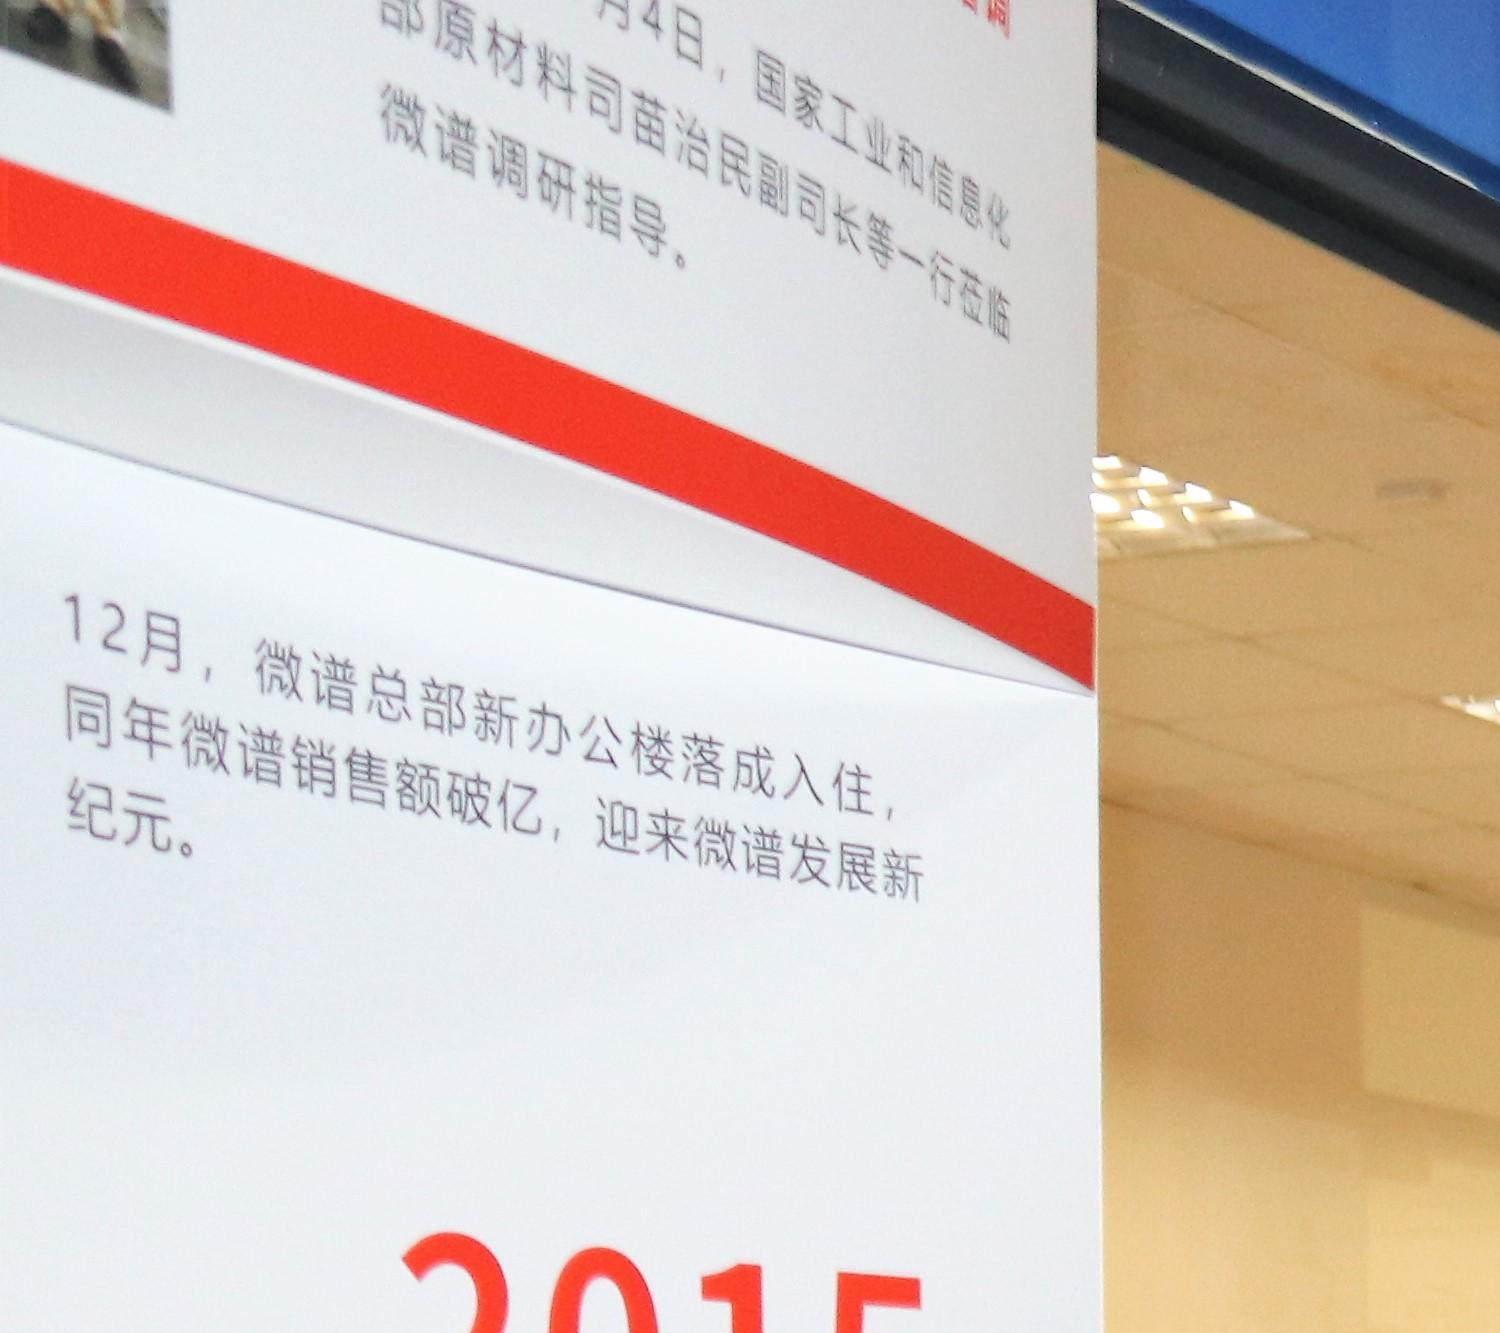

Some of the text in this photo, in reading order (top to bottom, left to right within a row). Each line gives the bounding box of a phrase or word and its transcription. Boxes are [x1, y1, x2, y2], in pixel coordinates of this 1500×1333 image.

[379, 82, 686, 271] 微谱调研指导。
[64, 682, 925, 903] 同年微谱销售额破亿，迎来微谱发展新
[67, 777, 196, 861] 纪元。
